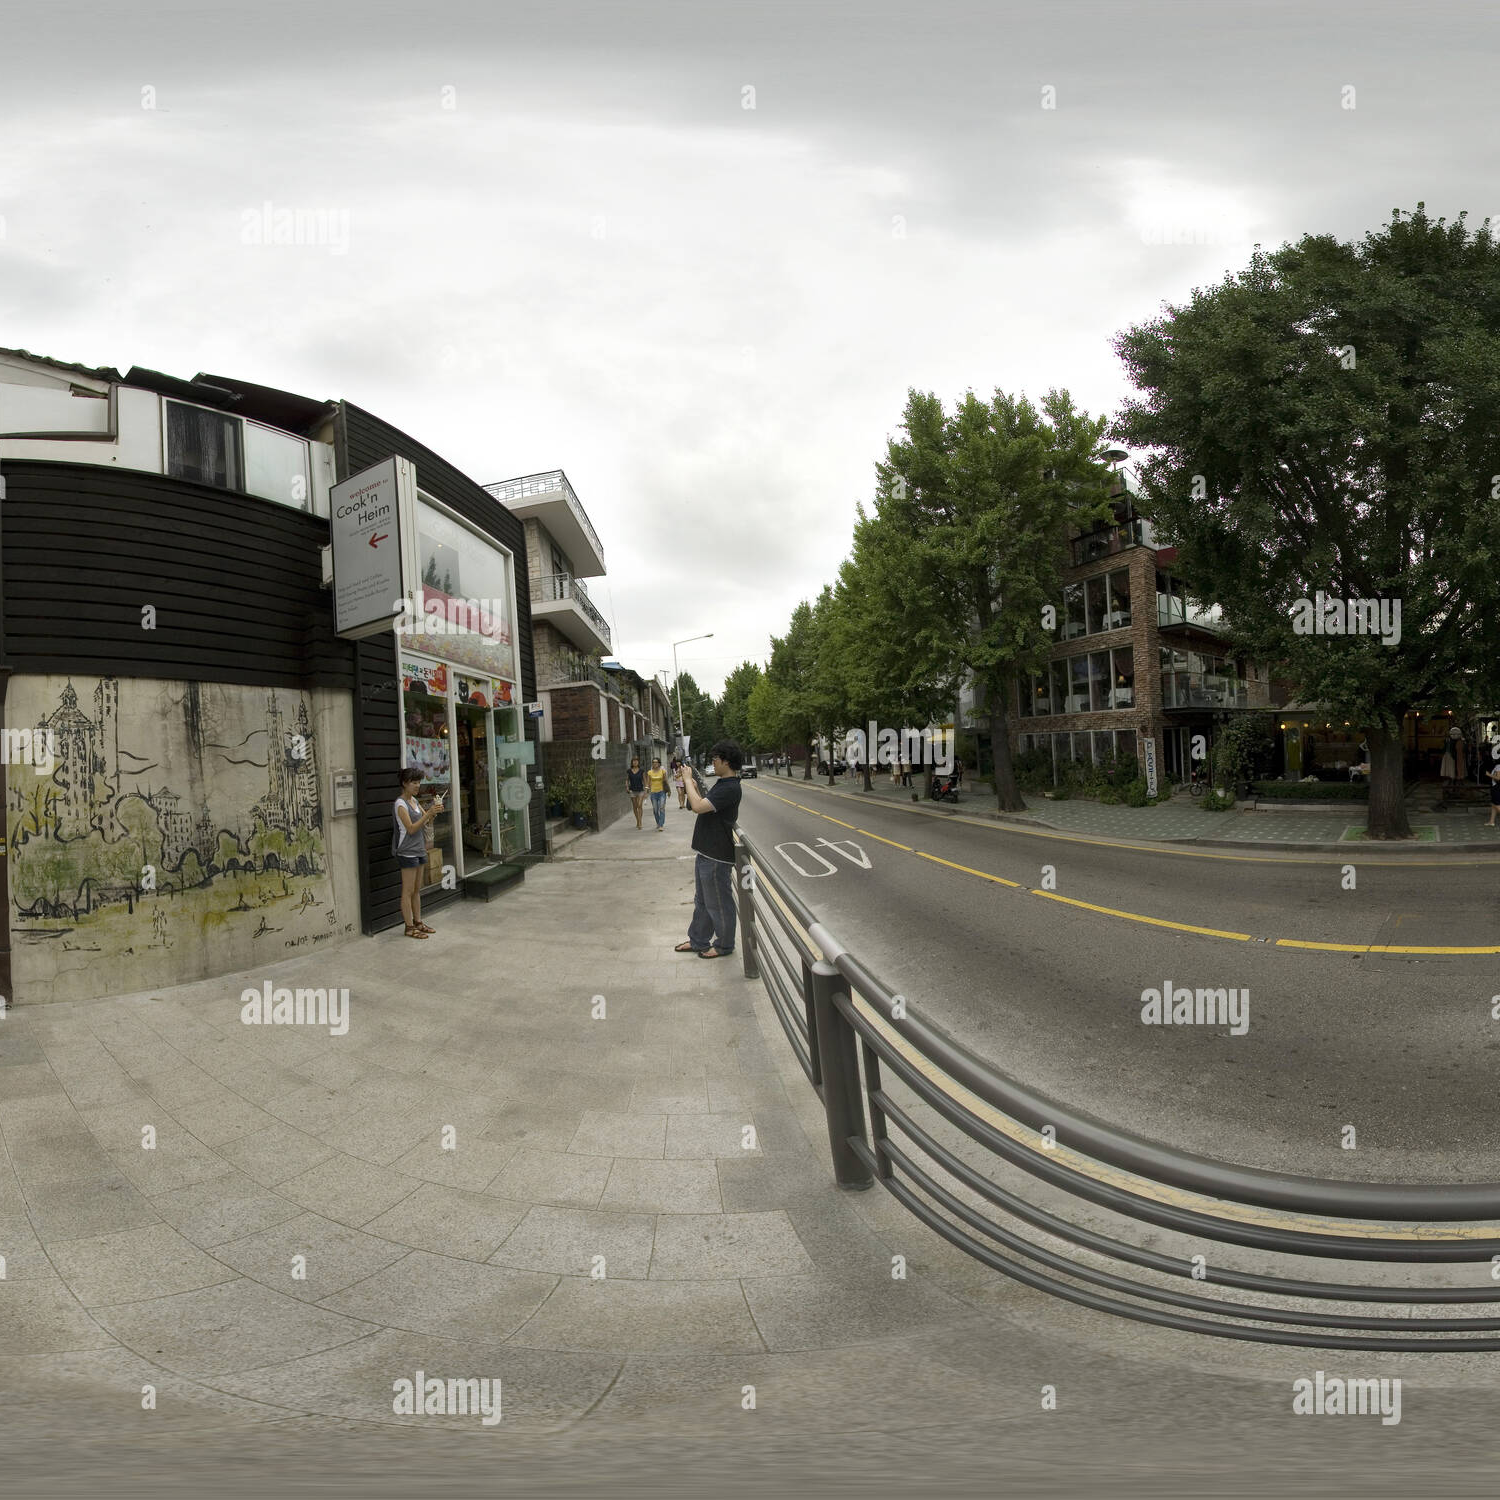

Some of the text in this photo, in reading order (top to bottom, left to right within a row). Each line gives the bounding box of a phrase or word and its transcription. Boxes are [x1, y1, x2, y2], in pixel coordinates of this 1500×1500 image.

[349, 481, 381, 500] welcome
[336, 493, 378, 519] Cook'n
[358, 505, 390, 526] Heim
[774, 837, 873, 878] 40
